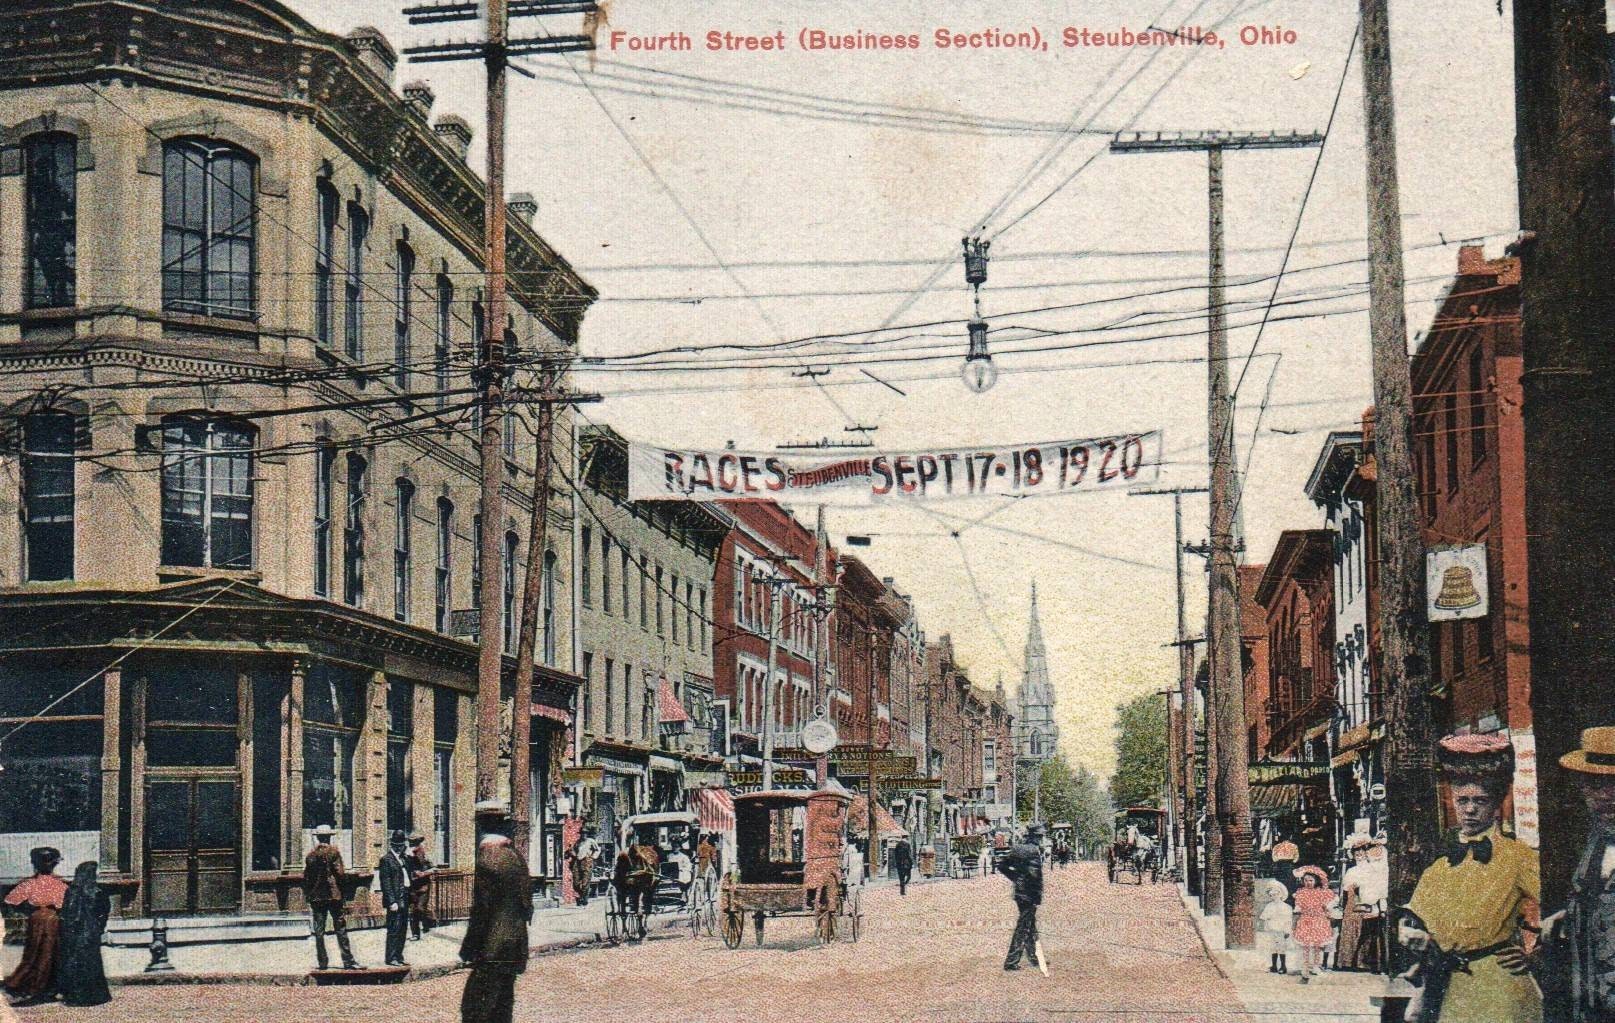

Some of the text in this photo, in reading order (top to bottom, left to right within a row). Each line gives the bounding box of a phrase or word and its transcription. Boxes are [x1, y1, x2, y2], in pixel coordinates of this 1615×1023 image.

[664, 452, 786, 494] RACES
[787, 459, 872, 488] STEUBENVILLE
[871, 454, 958, 497] SEPT
